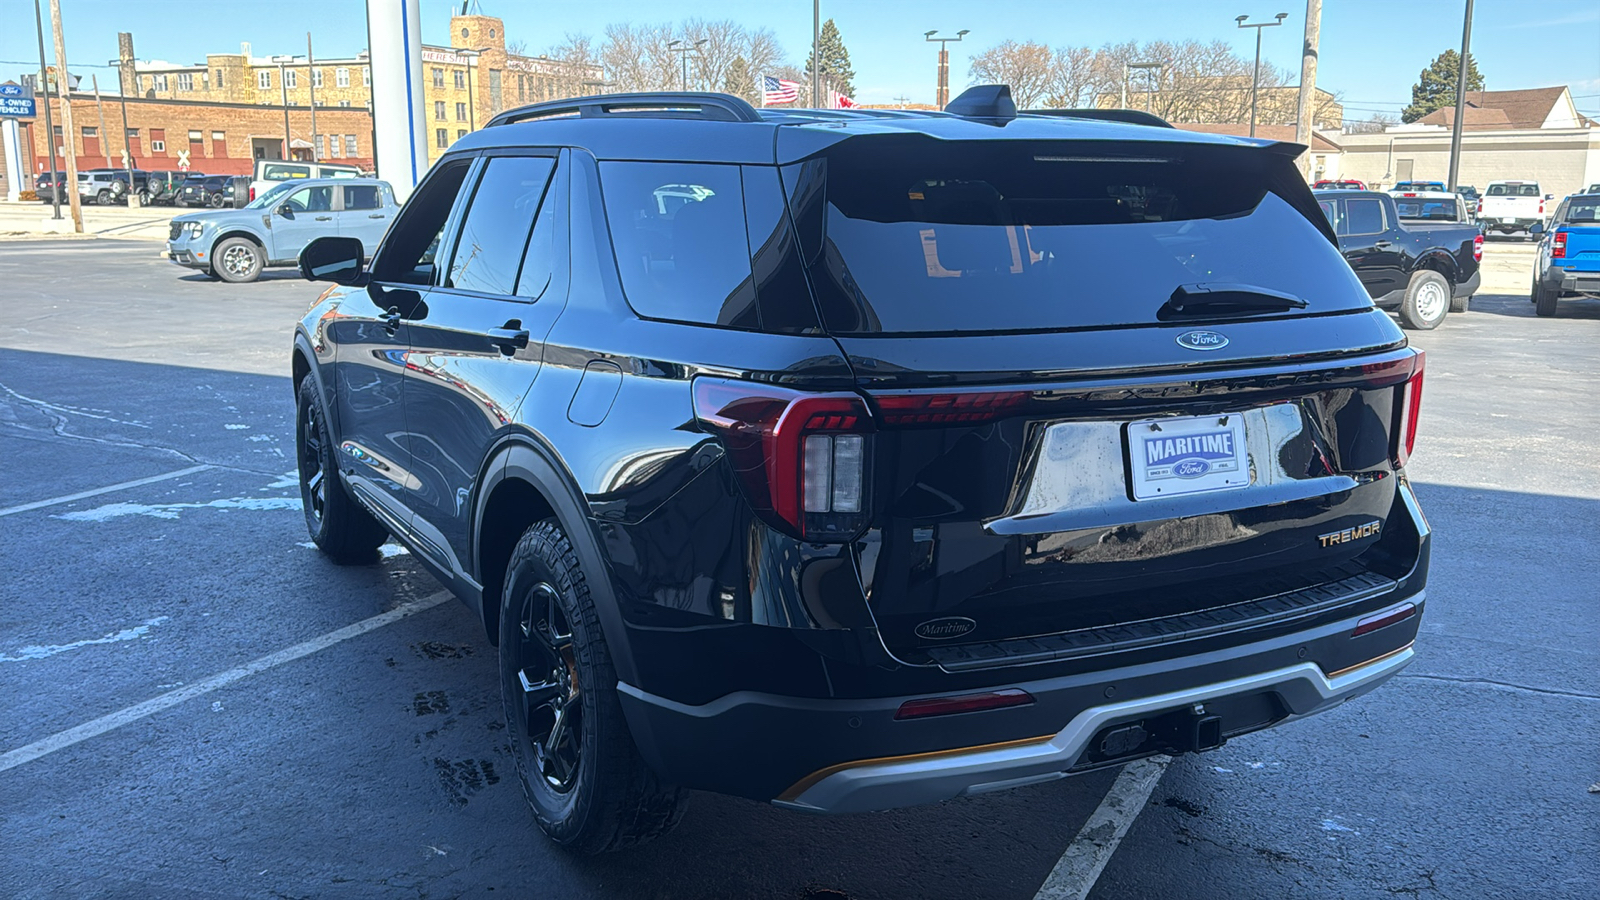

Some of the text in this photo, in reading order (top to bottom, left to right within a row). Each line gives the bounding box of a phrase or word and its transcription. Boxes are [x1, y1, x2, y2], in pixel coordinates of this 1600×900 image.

[1190, 332, 1219, 345] Ford
[1147, 433, 1232, 464] MARITIME
[1180, 462, 1202, 474] Ford
[1318, 520, 1380, 547] TREMOR
[922, 621, 970, 635] Maritime
